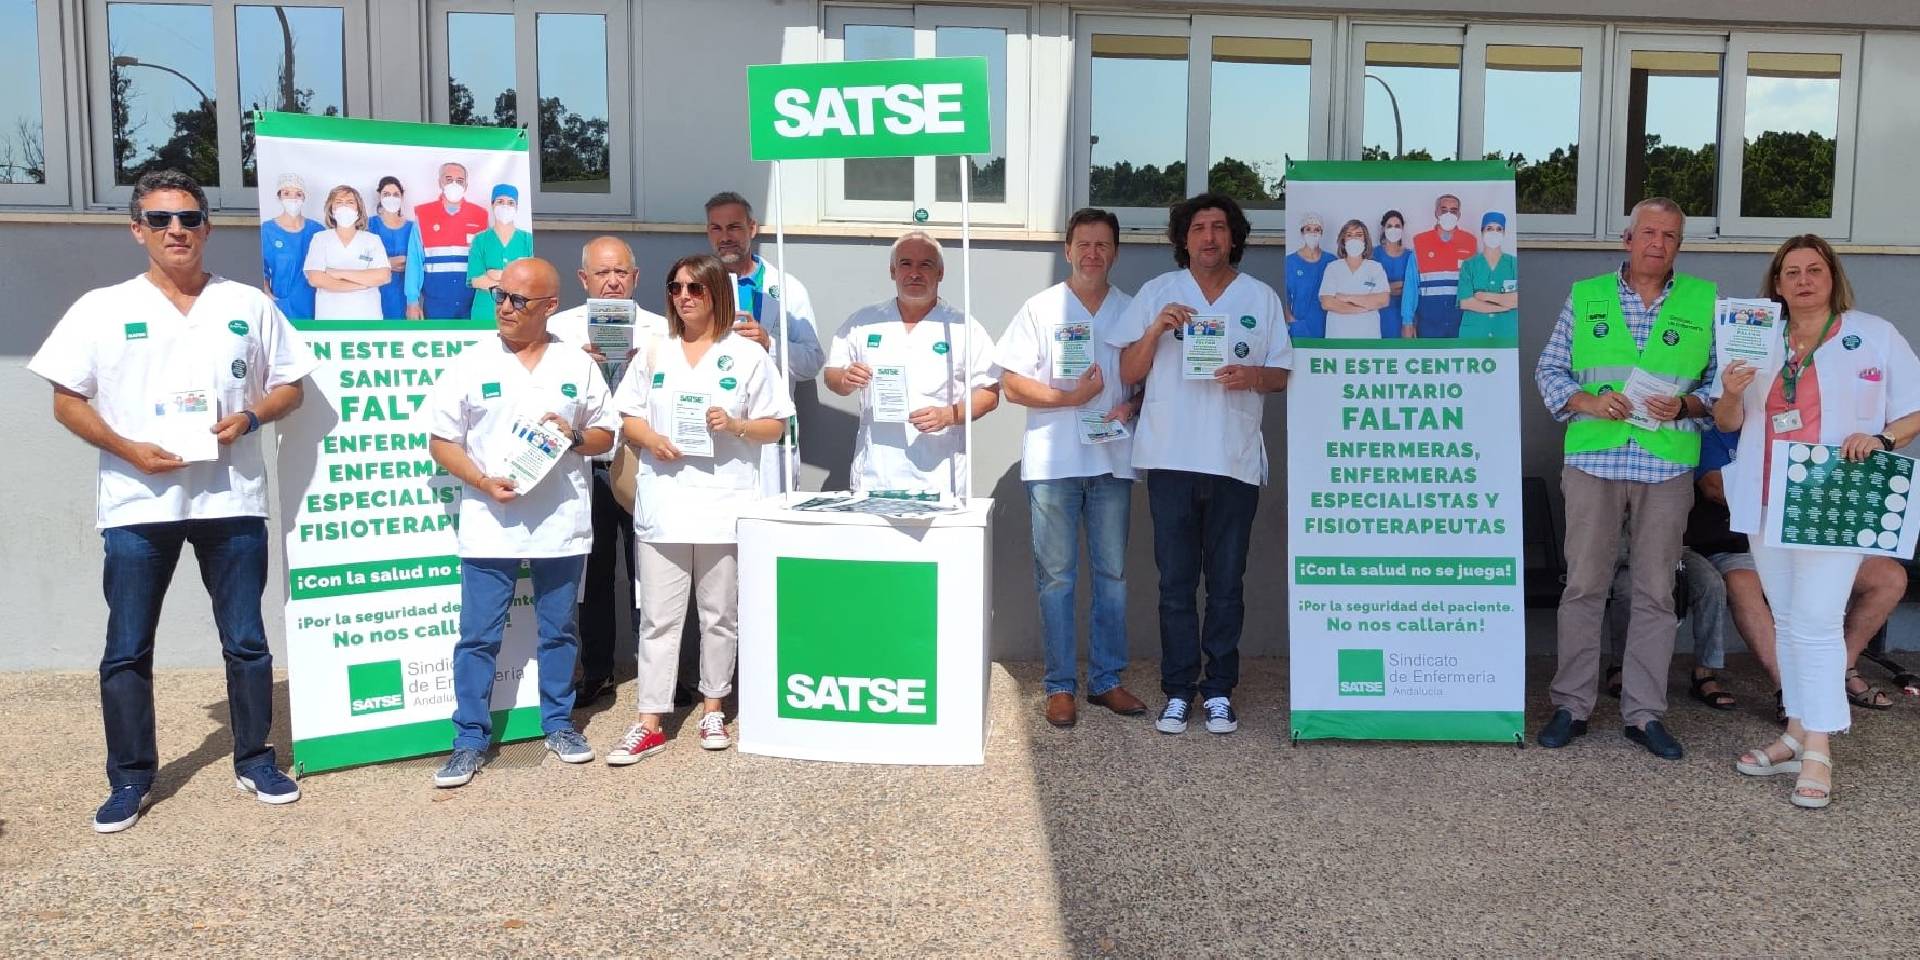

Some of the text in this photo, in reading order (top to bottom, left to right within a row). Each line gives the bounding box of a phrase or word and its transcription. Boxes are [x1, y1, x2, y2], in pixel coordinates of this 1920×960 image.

[773, 83, 965, 138] SATSE
[304, 341, 478, 361] N ESTE CEN
[1310, 357, 1497, 374] EN ESTE CENTRO
[340, 369, 445, 388] SANITA
[1343, 383, 1463, 399] SANITARIO
[341, 394, 427, 422] FALT
[1342, 406, 1463, 431] FALTAN
[324, 432, 427, 454] ENFERM
[1326, 441, 1481, 461] ENFERMERAS,
[329, 459, 450, 483] ENFERME
[1330, 466, 1477, 484] ENFERMERAS
[307, 485, 462, 513] ESPECIALIS
[1311, 492, 1500, 508] ESPECIALISTAS Y
[300, 513, 460, 542] FISIOTERAP
[1304, 517, 1506, 534] FISIOTERAPEUTAS
[298, 575, 341, 590] ¡Con
[347, 572, 366, 585] la
[370, 565, 424, 584] salud
[429, 565, 452, 578] no
[1300, 563, 1511, 580] ¡Con la salud no se juega!
[298, 601, 462, 630] ¡Por la seguridad de
[1299, 600, 1515, 614] ¡Por la seguridad del paciente.
[1327, 617, 1485, 632] No nos callarán!
[333, 630, 364, 649] No
[370, 627, 409, 643] nos
[408, 657, 453, 676] Sindi
[1389, 652, 1458, 667] Sindicato
[409, 679, 429, 693] de
[1389, 670, 1408, 683] de
[786, 673, 927, 714] SATSE
[1340, 681, 1383, 693] SATSE
[352, 693, 403, 712] SATSE
